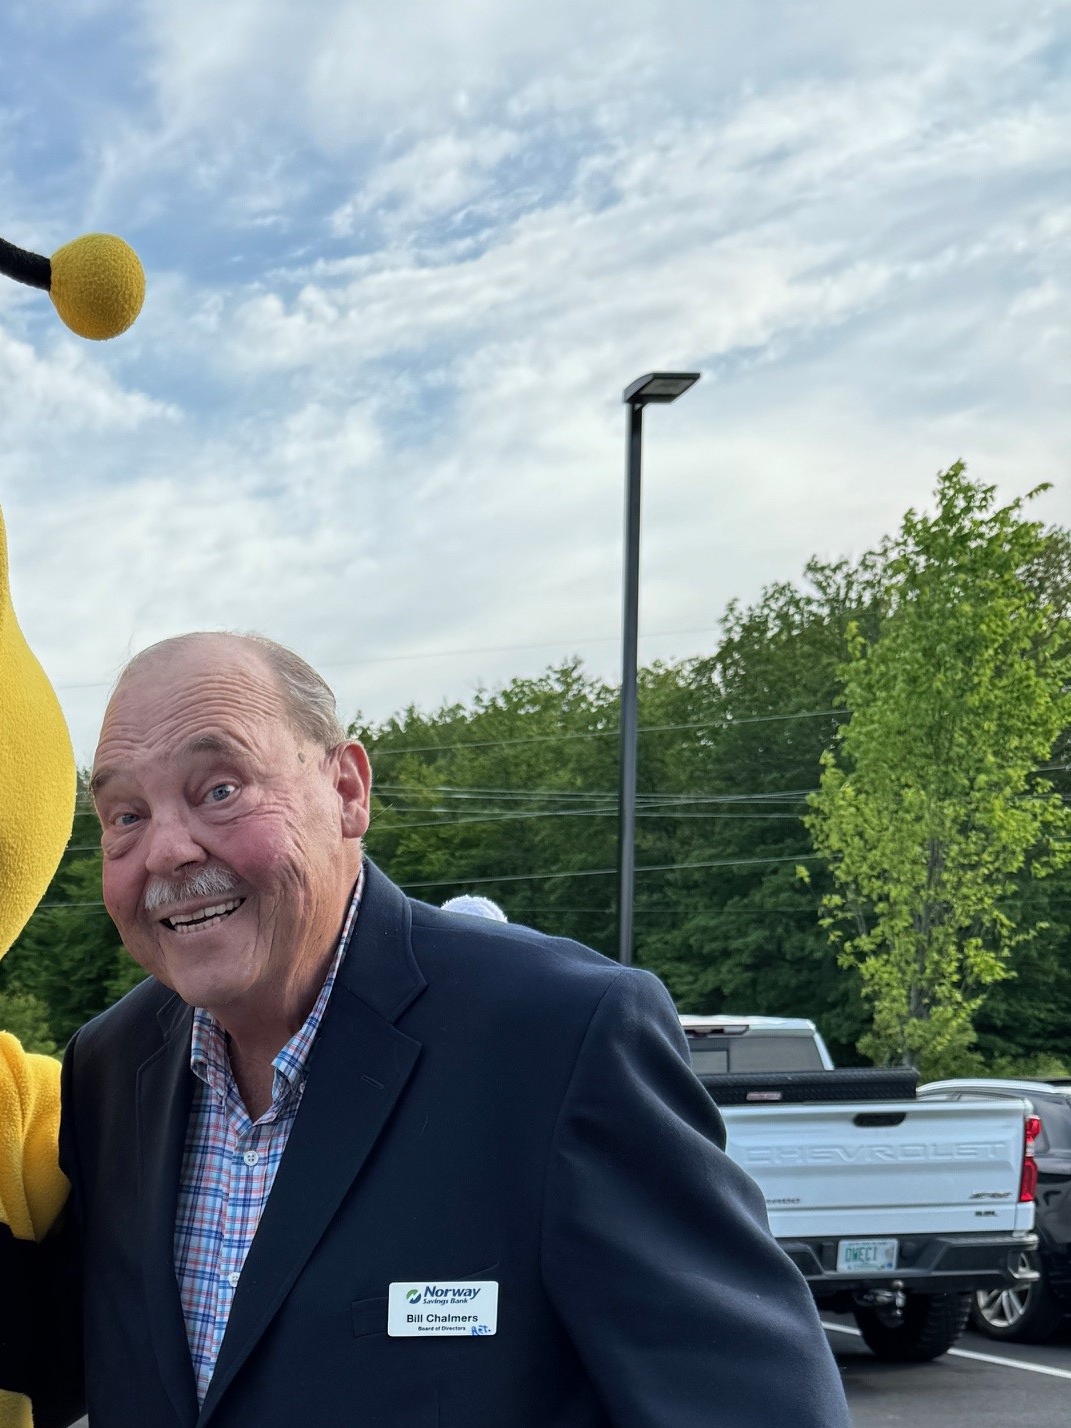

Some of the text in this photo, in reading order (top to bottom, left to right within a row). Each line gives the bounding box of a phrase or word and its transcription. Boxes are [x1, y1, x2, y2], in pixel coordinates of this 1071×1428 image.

[745, 1141, 1005, 1164] CHEVROLET
[423, 1286, 481, 1300] Norway
[423, 1298, 449, 1306] Savings
[406, 1314, 478, 1323] Bill Chalmers
